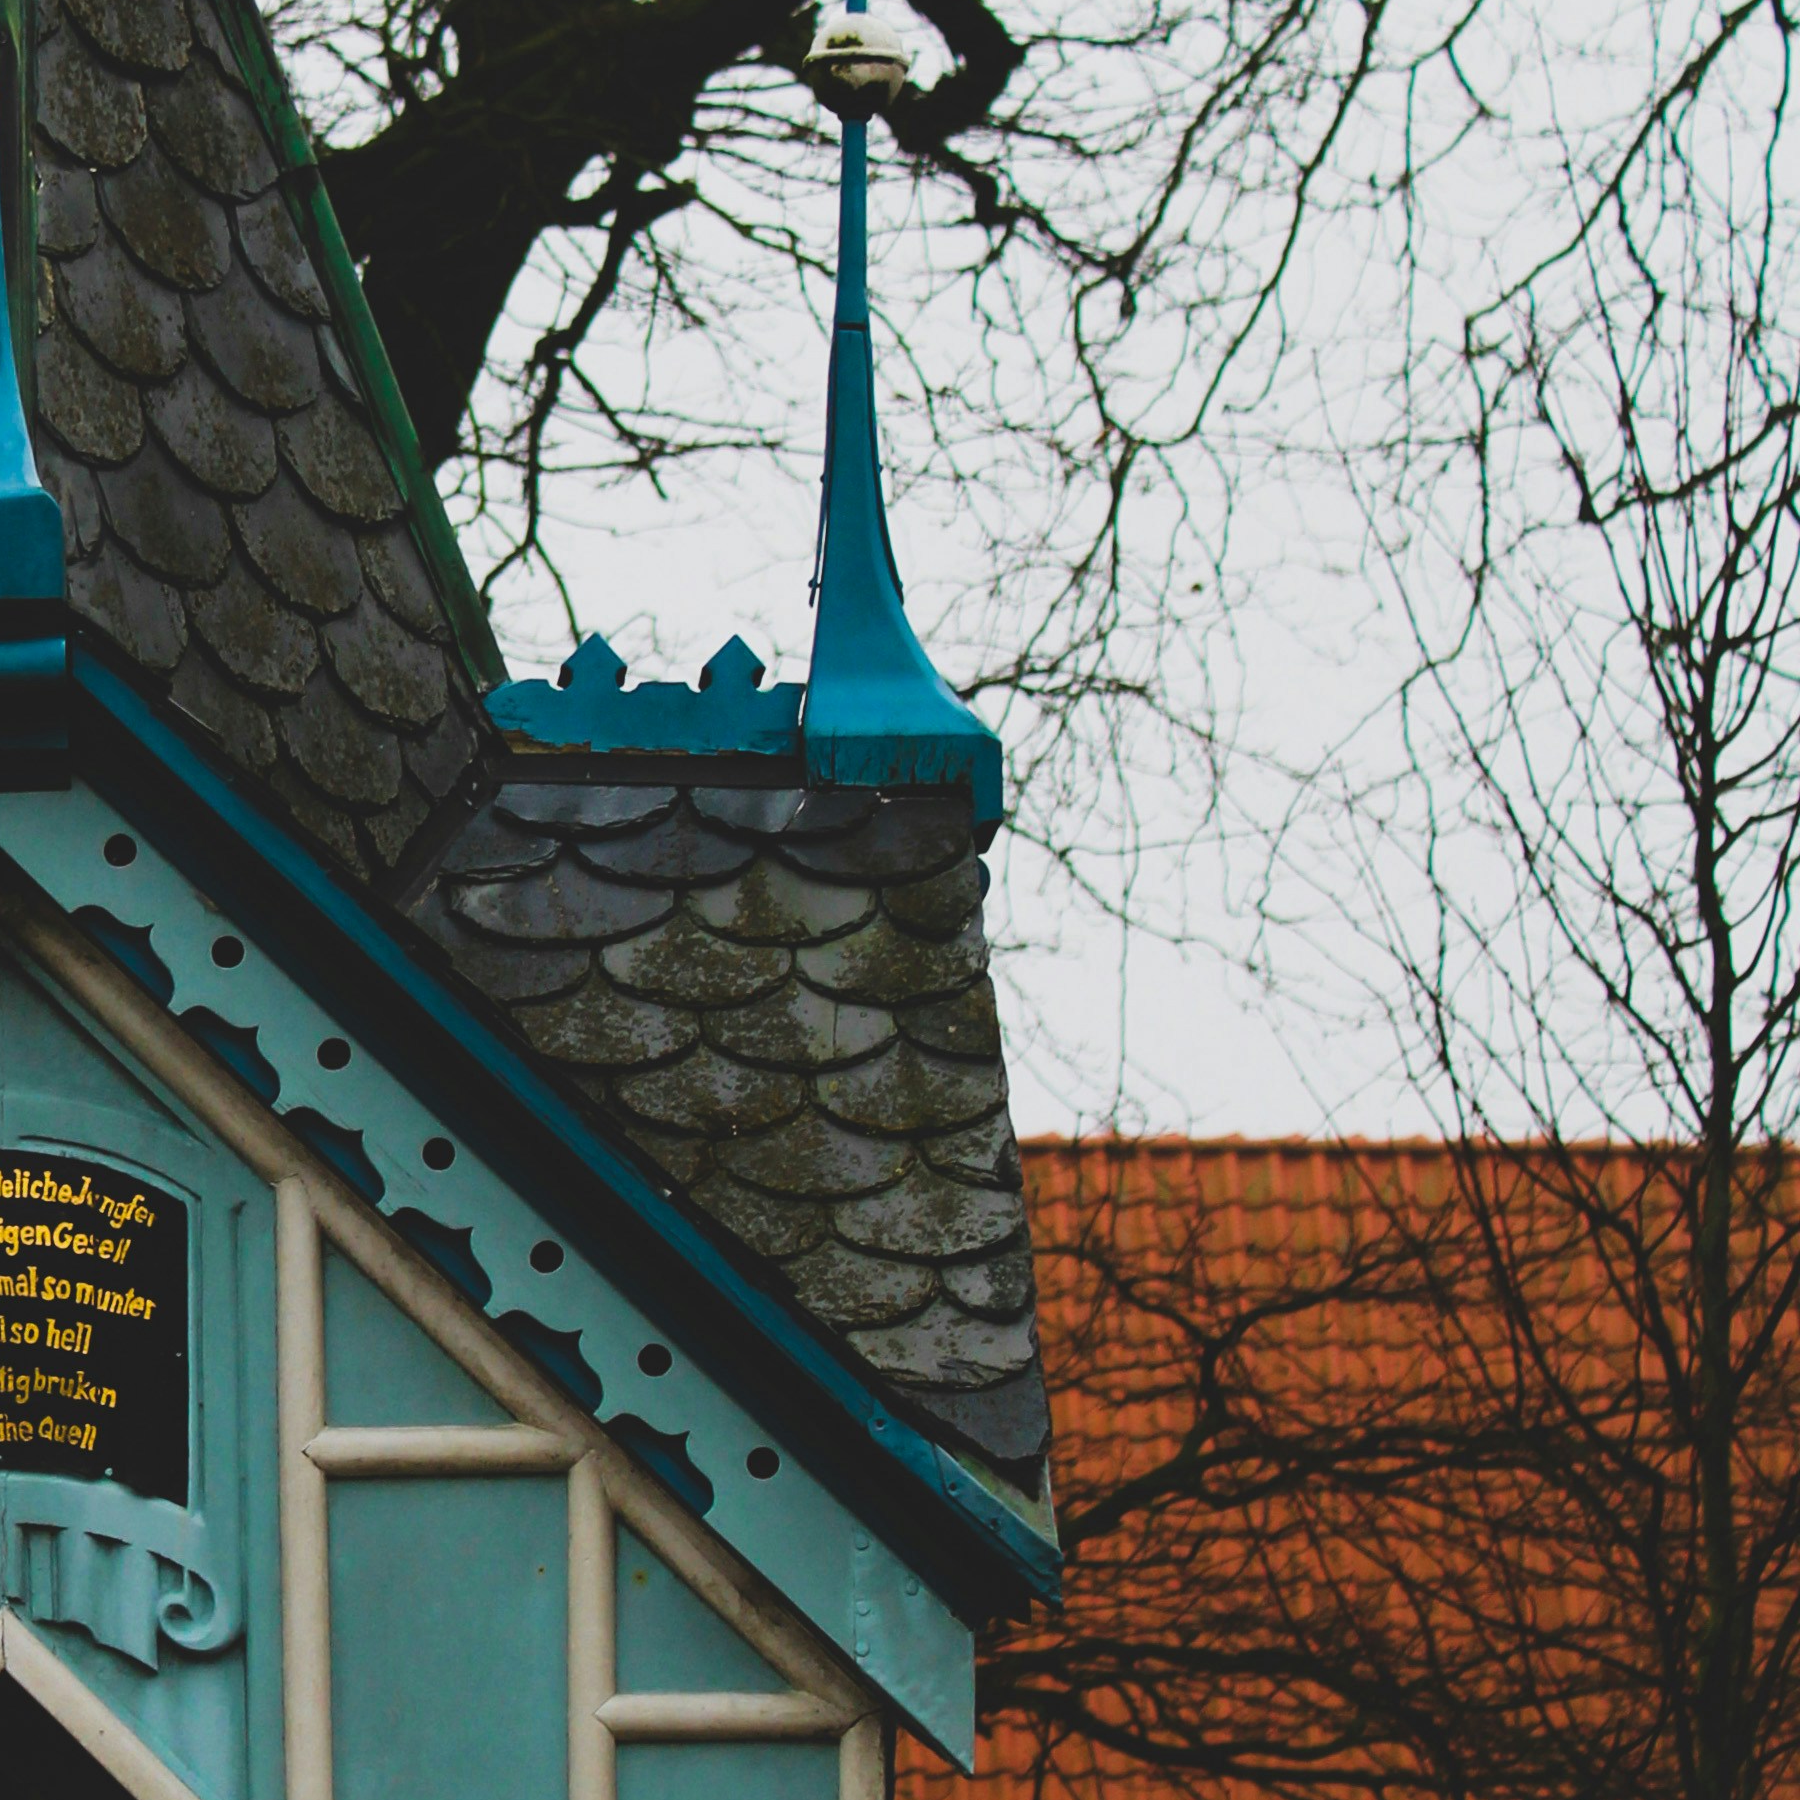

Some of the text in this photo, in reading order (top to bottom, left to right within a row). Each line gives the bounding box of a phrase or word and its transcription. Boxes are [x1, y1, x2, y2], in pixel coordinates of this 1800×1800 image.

[41, 1276, 71, 1301] so
[75, 1282, 156, 1320] munter
[10, 1322, 39, 1344] so
[46, 1318, 92, 1354] hell
[38, 1415, 97, 1450] Quell
